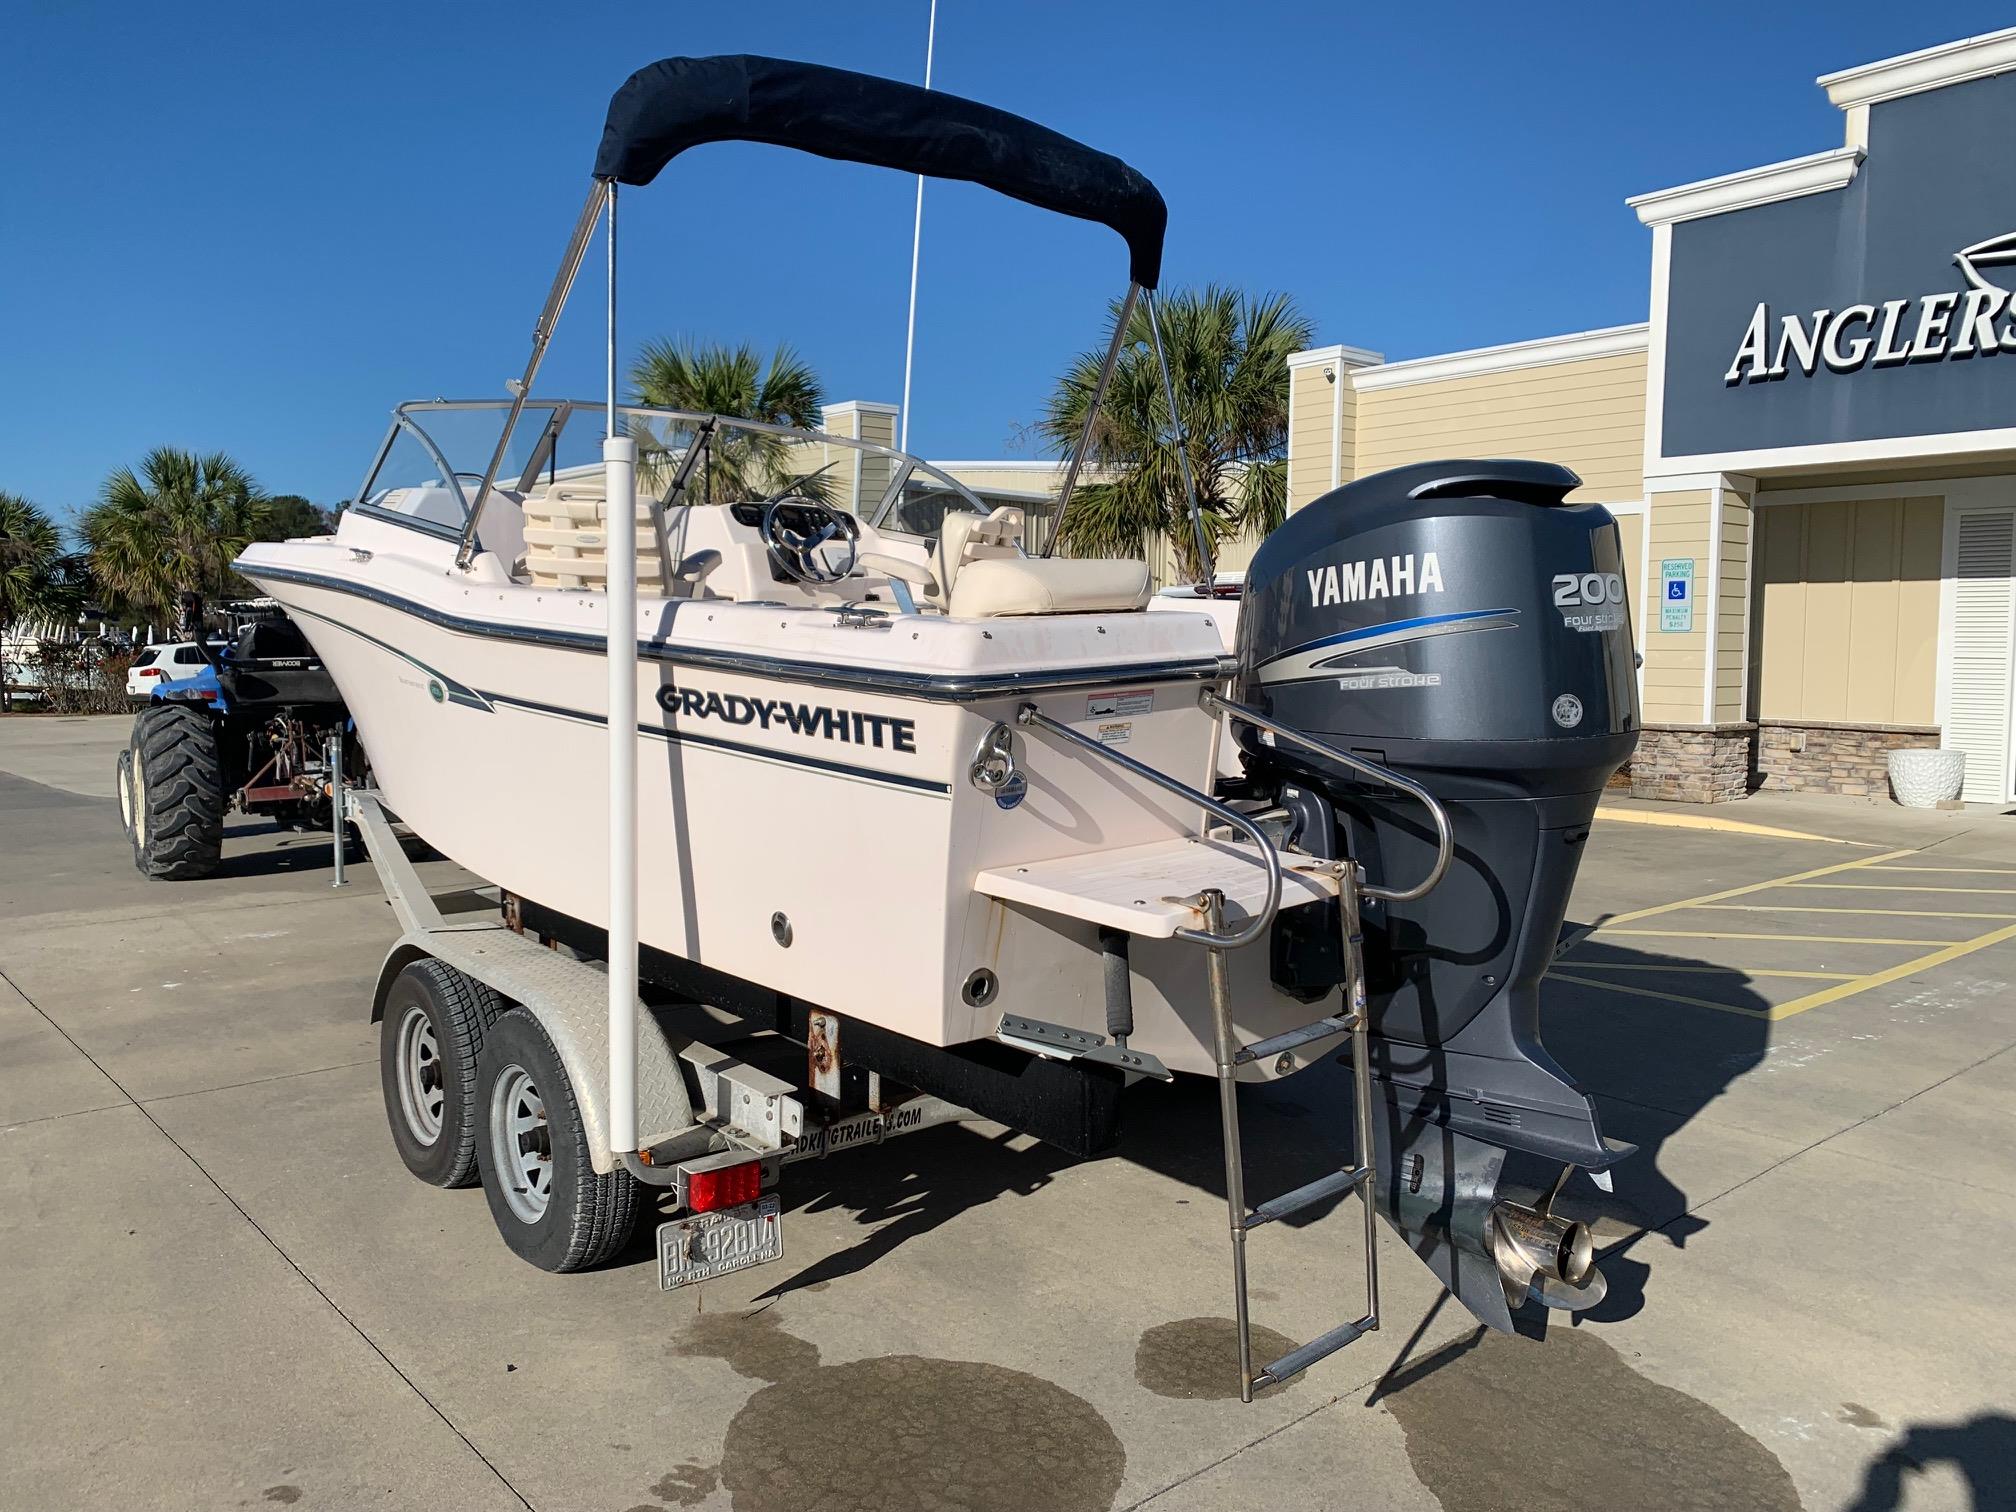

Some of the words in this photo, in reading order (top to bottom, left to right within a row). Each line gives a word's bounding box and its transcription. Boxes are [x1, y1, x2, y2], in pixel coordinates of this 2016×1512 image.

[1306, 552, 1445, 608] YAMAHA
[1663, 562, 1692, 570] RESERVED
[1665, 570, 1690, 578] PARKING
[1552, 573, 1623, 607] 200
[655, 684, 917, 754] GRADY-WHITE
[667, 1267, 711, 1287] NORTH
[718, 1249, 776, 1271] CAROLINA
